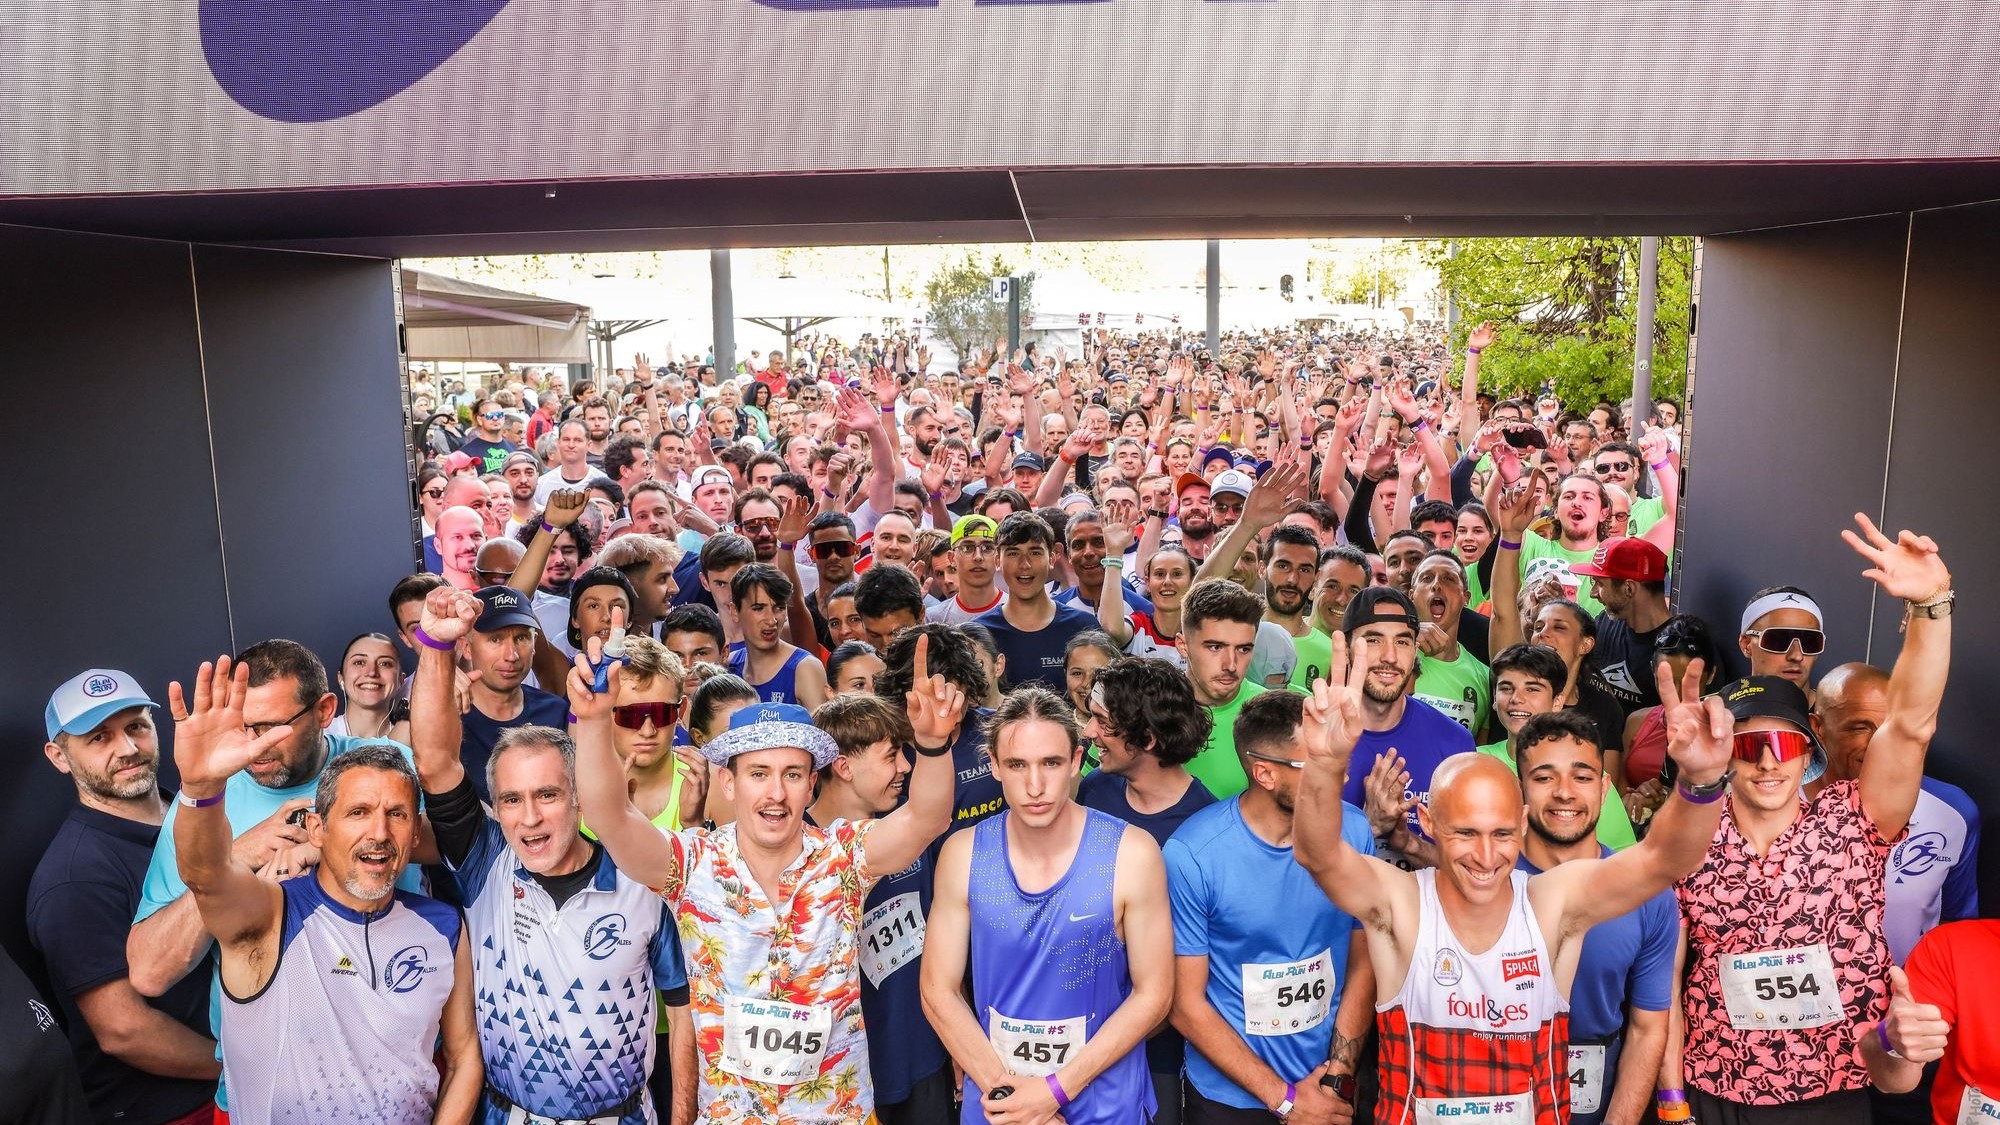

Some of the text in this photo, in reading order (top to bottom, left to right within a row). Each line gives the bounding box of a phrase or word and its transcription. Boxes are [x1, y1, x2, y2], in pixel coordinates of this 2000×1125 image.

[1001, 281, 1008, 298] P
[489, 593, 518, 607] TARN
[1729, 687, 1764, 701] RICARD
[758, 709, 781, 721] Run
[958, 797, 1003, 820] MARCO
[888, 899, 902, 912] #5
[867, 910, 917, 954] 1311
[1263, 960, 1322, 980] ALBI RUN #5
[1734, 953, 1805, 970] ALBI RUN #5
[1277, 978, 1326, 1007] 546
[1755, 973, 1821, 1001] 554
[742, 1003, 810, 1021] ALBI RUN #5
[1001, 1021, 1066, 1035] ALBI RUN #5
[745, 1025, 822, 1055] 1045
[1473, 1032, 1494, 1042] enjoy
[1496, 1032, 1527, 1043] running
[1013, 1041, 1070, 1064] 457
[1569, 1068, 1587, 1088] 4
[1436, 1101, 1515, 1116] ALBI RUN #5
